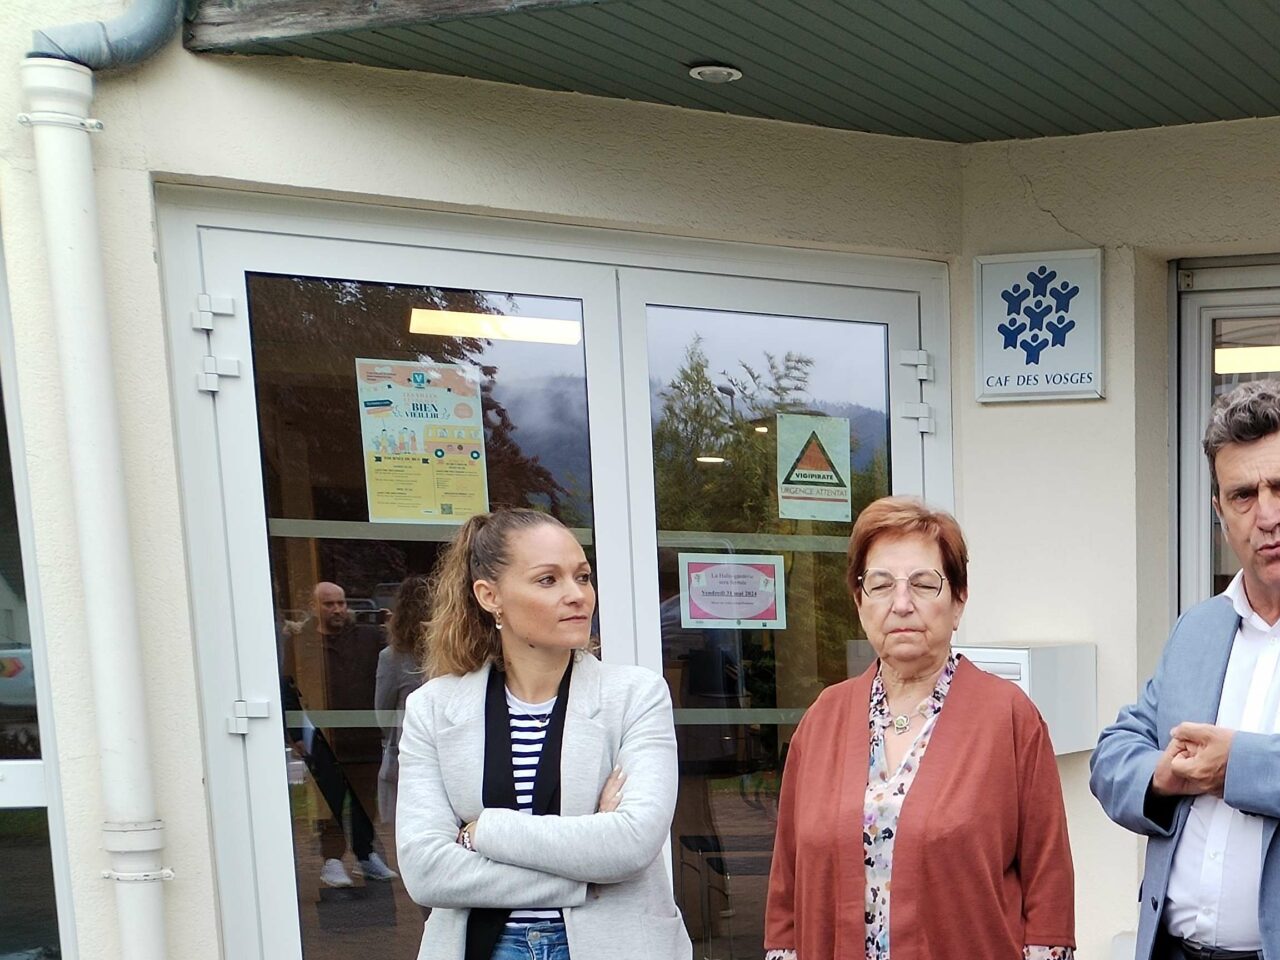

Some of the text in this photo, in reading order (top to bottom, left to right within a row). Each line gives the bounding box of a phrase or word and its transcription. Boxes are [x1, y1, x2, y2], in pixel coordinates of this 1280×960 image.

[986, 372, 1093, 388] CAF DES VOSGES
[795, 472, 834, 481] VIGIPIRATE
[780, 486, 847, 498] URGENCE ATTENTAT
